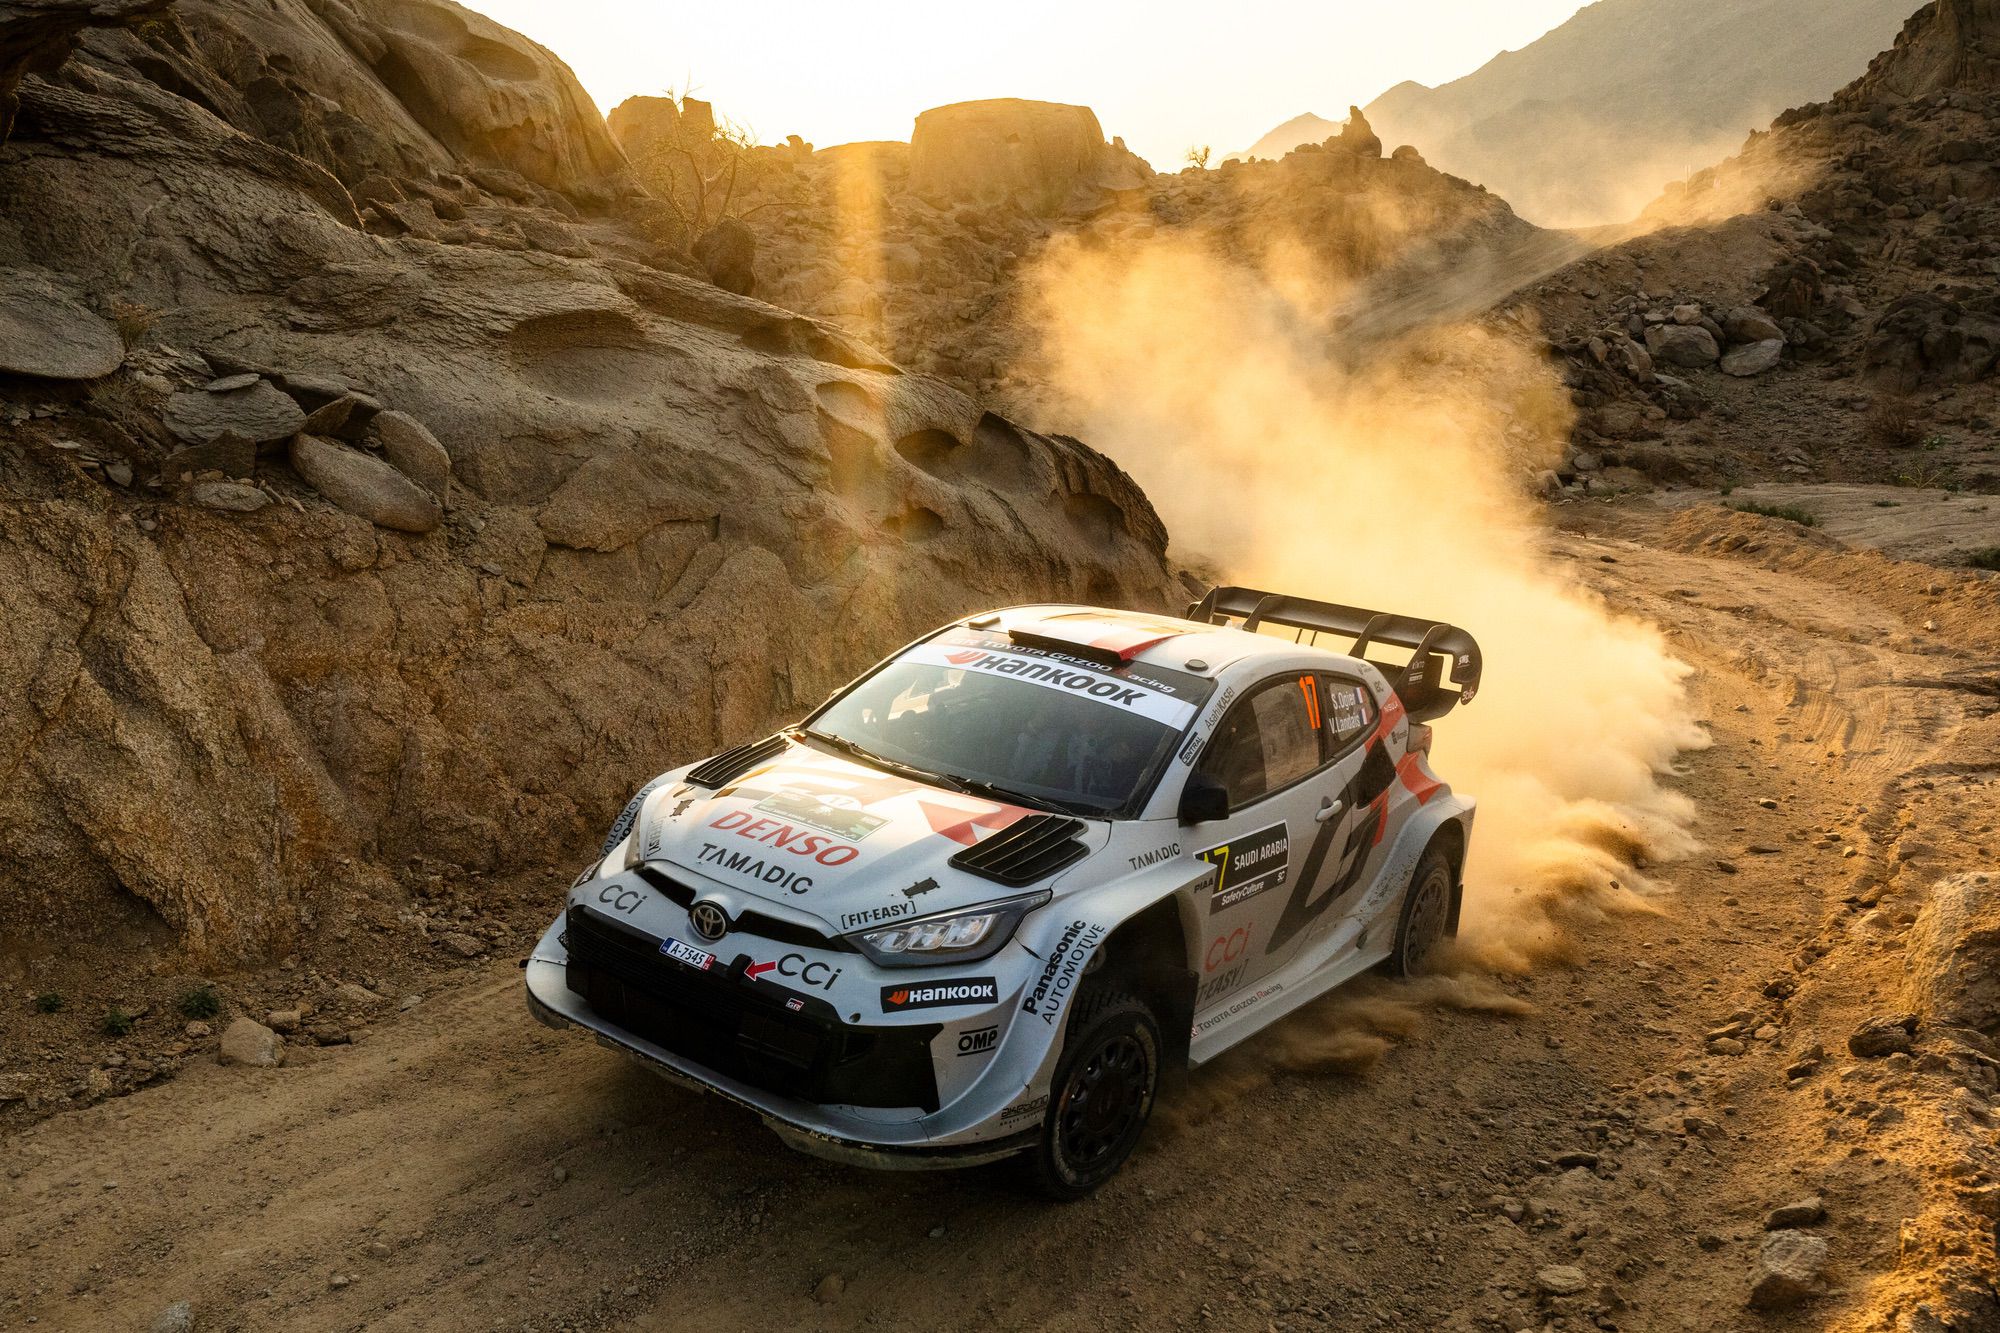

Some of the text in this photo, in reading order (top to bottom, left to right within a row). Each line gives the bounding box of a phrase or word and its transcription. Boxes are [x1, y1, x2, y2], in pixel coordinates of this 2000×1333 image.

[1049, 652, 1112, 672] GAZOO
[1299, 675, 1321, 730] 17
[708, 809, 860, 867] DENSO
[1128, 842, 1181, 871] TAMADIC
[1234, 837, 1288, 871] SAUDI ARABIA
[696, 842, 813, 895] TAMADIC
[1203, 845, 1230, 892] 7
[670, 943, 705, 965] A-7545
[1021, 919, 1087, 1016] Panasonic
[1041, 923, 1105, 1026] AUTOMOTIVE
[1197, 983, 1284, 1032] TOYOTA GAZOO Racing
[958, 1029, 998, 1052] OMP
